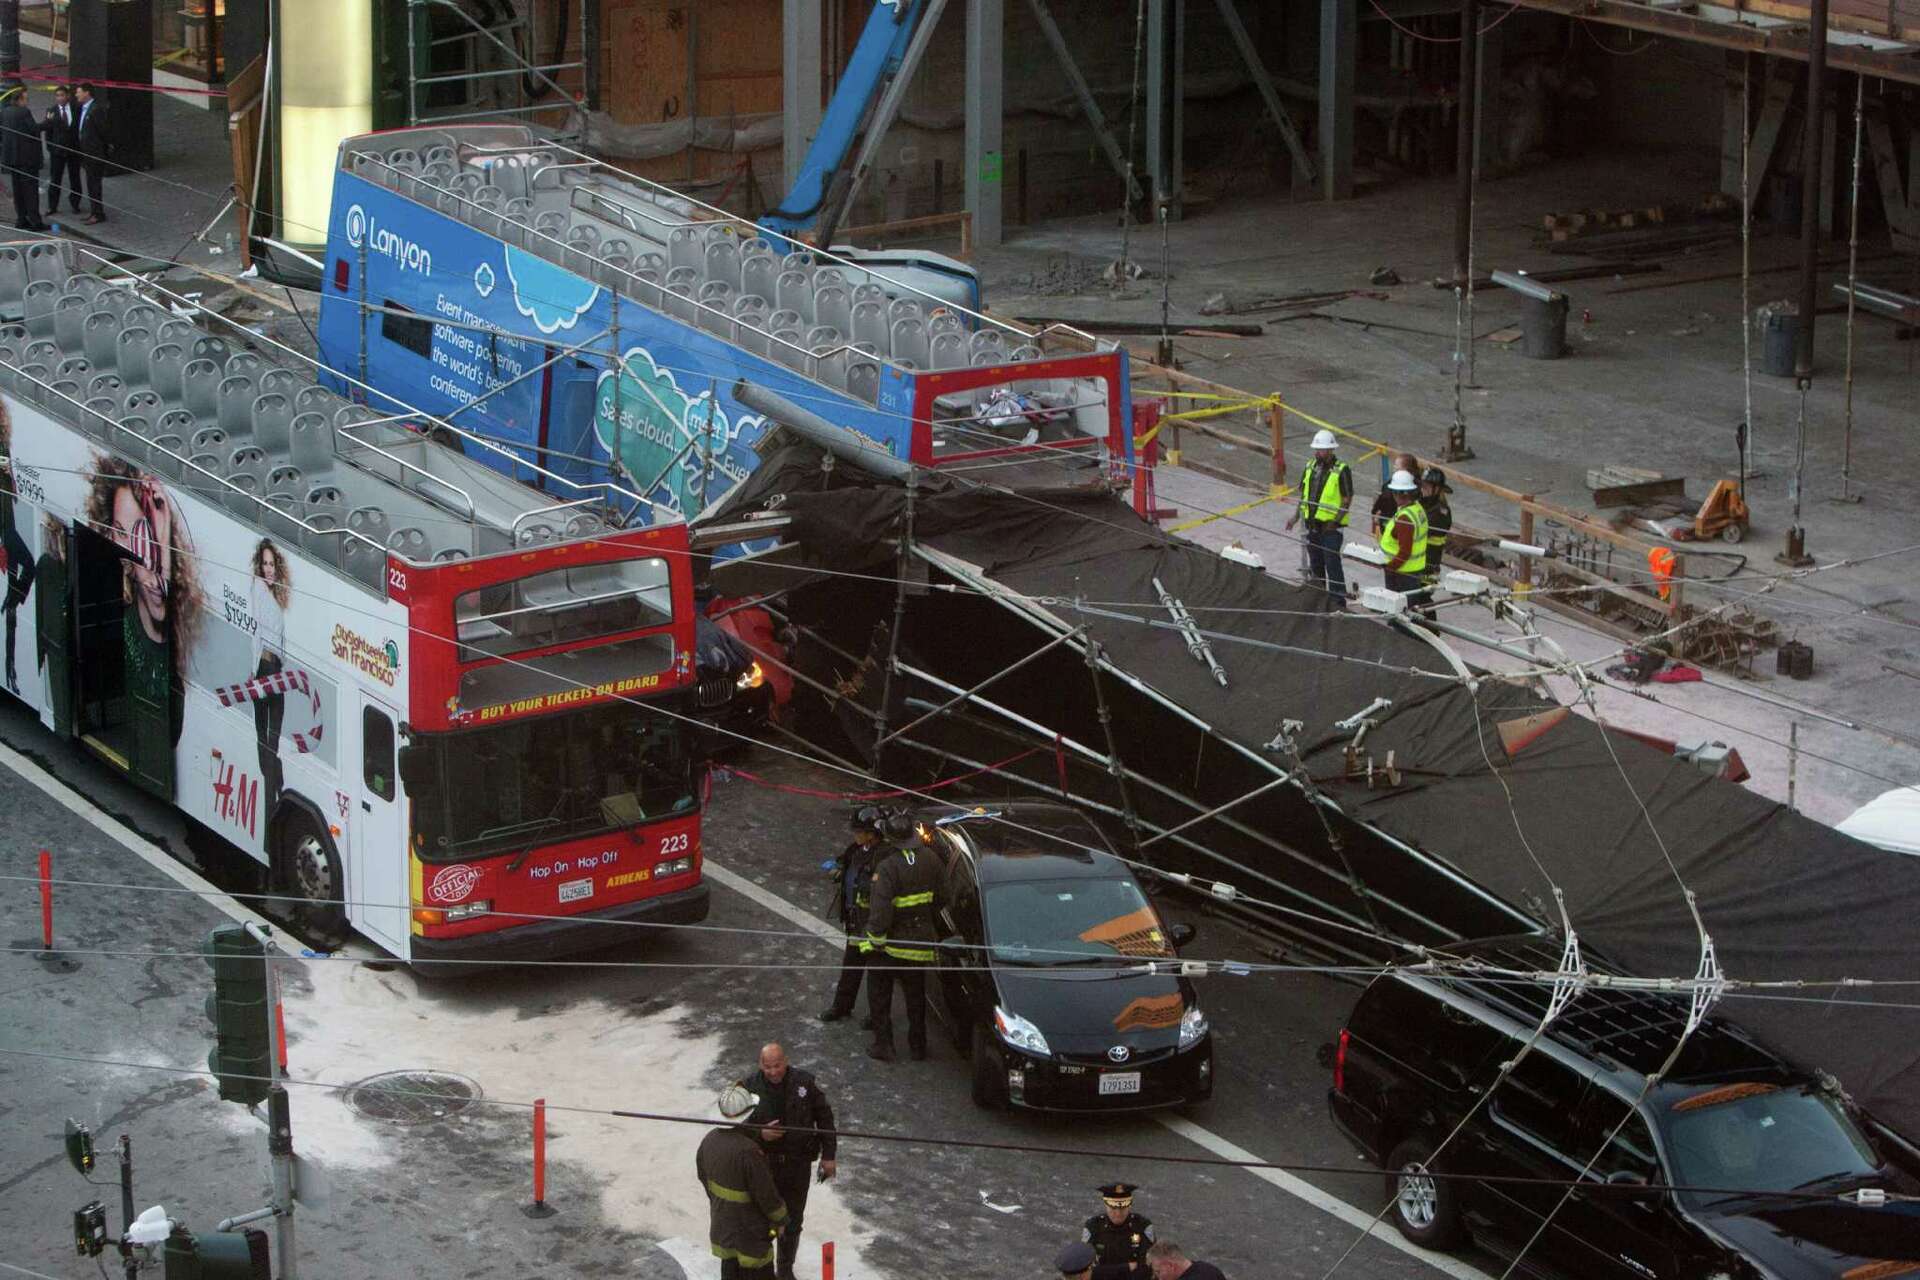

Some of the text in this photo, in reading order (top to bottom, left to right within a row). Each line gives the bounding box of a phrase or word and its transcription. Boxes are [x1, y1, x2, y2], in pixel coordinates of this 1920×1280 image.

[370, 216, 431, 277] Lanyon
[436, 294, 462, 320] Event
[433, 323, 475, 353] software
[432, 345, 447, 367] the
[450, 357, 483, 385] world's
[600, 396, 634, 431] Saes
[389, 568, 407, 591] 223
[223, 583, 247, 609] Blouse
[331, 635, 395, 687] San Francisco
[481, 675, 660, 720] BUY YOUR TICKETS ON BOARD
[212, 759, 258, 841] H&M
[660, 833, 688, 855] 223
[530, 851, 619, 880] Hop On Hop Off
[606, 869, 650, 888] ATHENS
